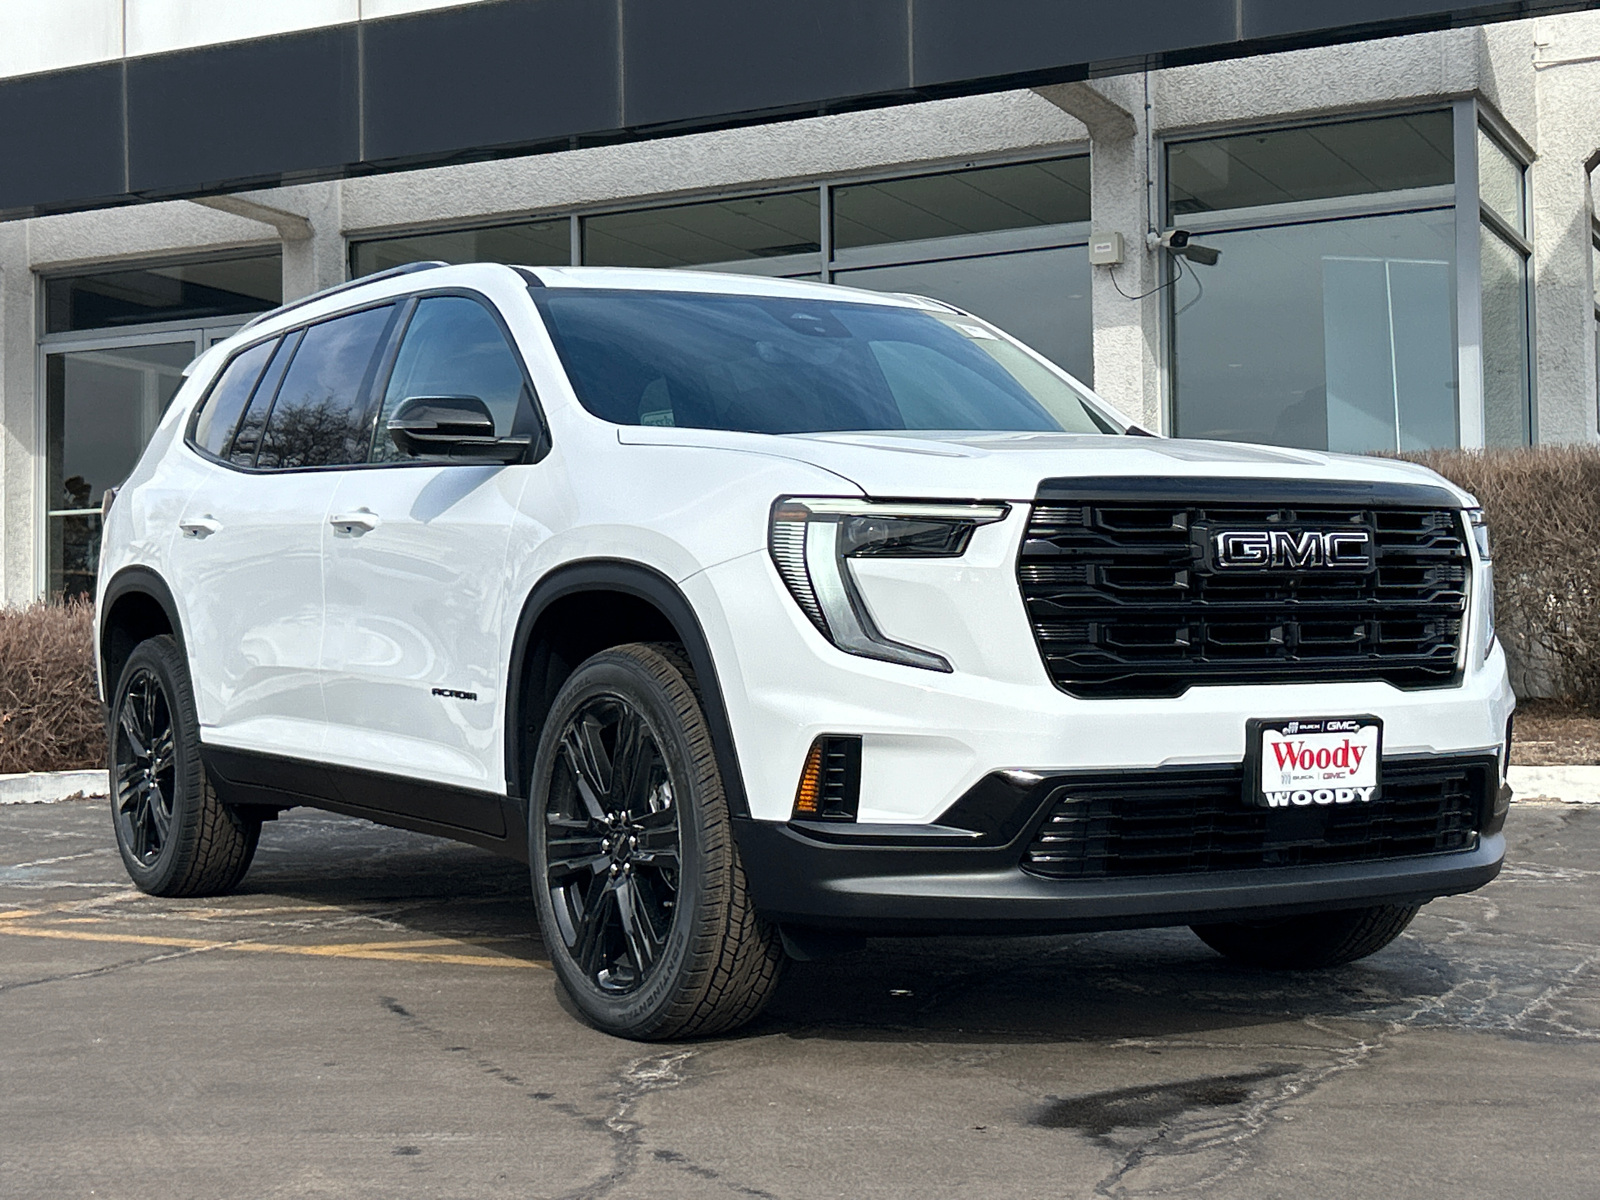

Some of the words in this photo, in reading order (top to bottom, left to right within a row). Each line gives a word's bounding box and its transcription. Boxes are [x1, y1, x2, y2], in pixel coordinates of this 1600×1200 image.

[1217, 531, 1369, 567] GMC
[1326, 721, 1356, 730] GMC
[1271, 739, 1367, 775] Woody
[1323, 772, 1346, 780] GMC
[1265, 787, 1375, 807] WOODY
[619, 932, 684, 1020] CONTINENTAL
